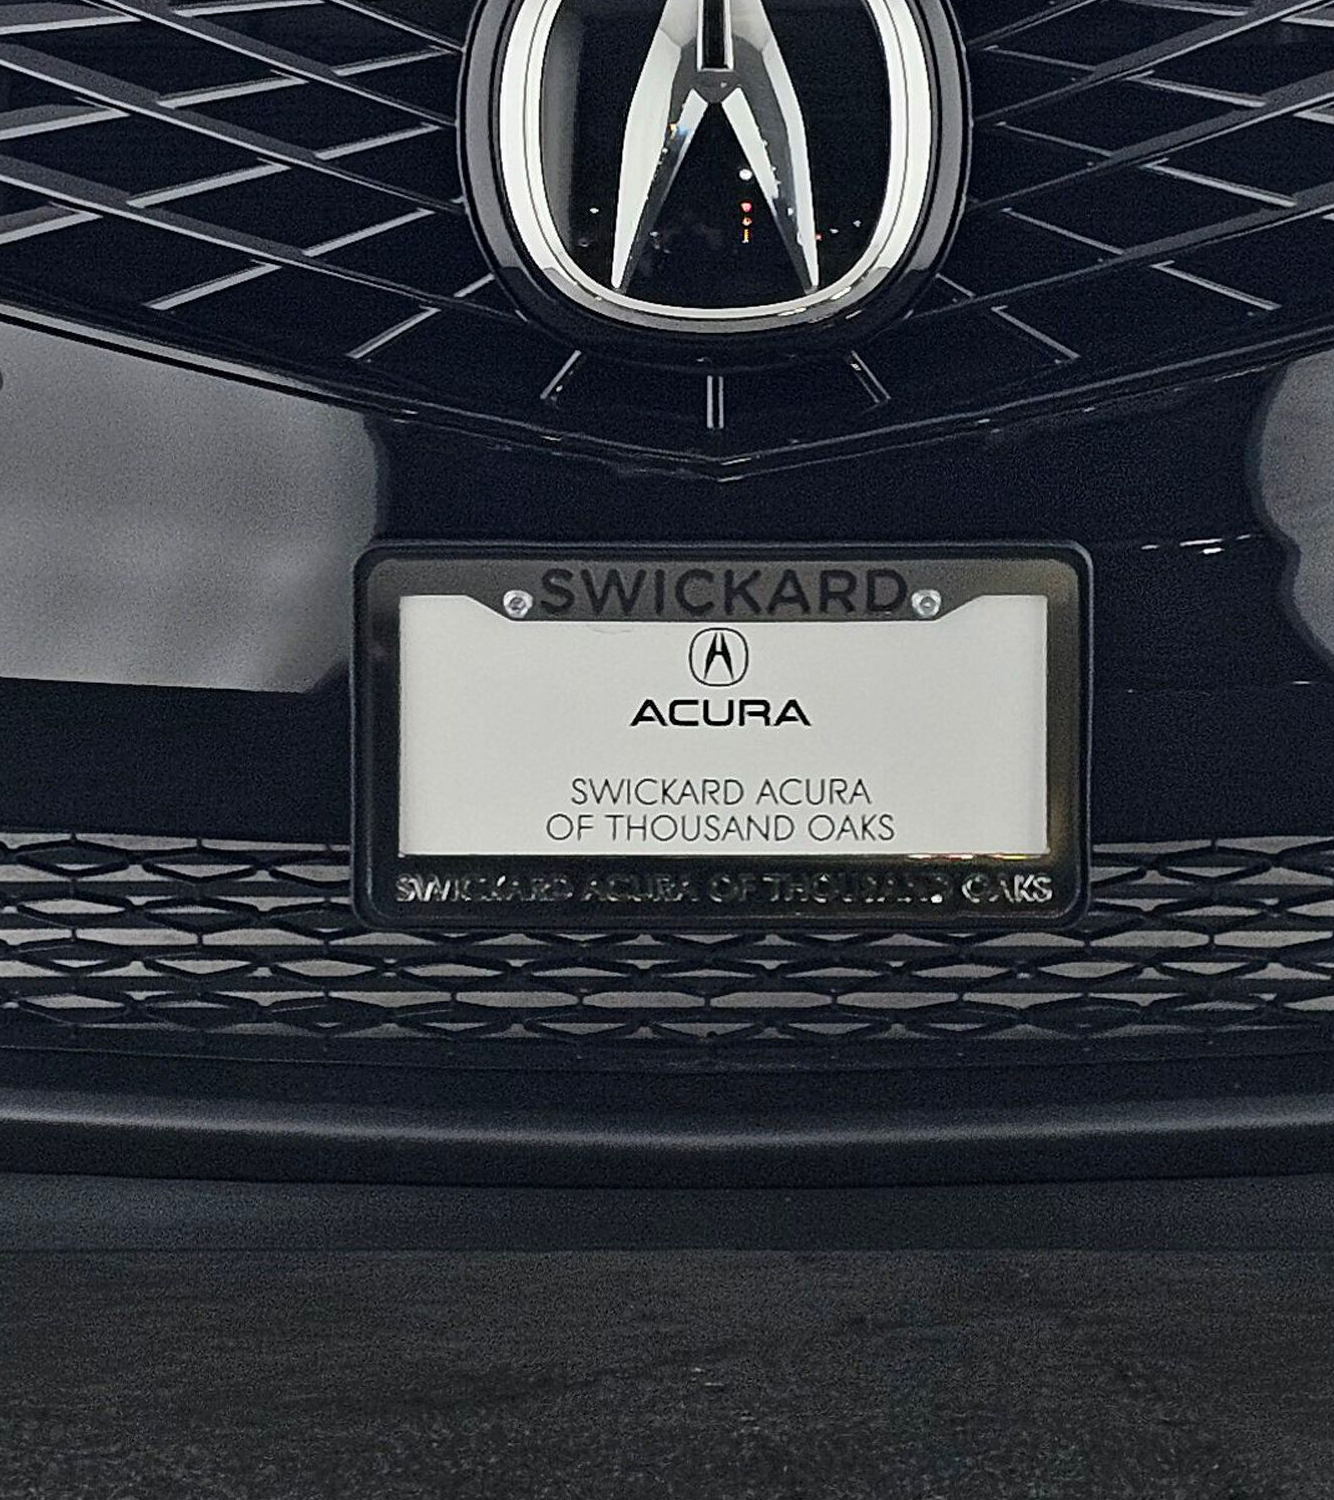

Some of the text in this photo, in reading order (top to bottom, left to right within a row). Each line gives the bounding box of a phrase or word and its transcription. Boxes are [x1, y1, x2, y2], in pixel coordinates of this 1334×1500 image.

[540, 568, 909, 615] SWICKARD
[629, 699, 812, 727] ACURA
[570, 777, 872, 806] SWICKARD ACURA
[546, 813, 896, 842] OF THOUSAND OAKS
[707, 873, 757, 902] OF
[961, 873, 1054, 903] OAKS
